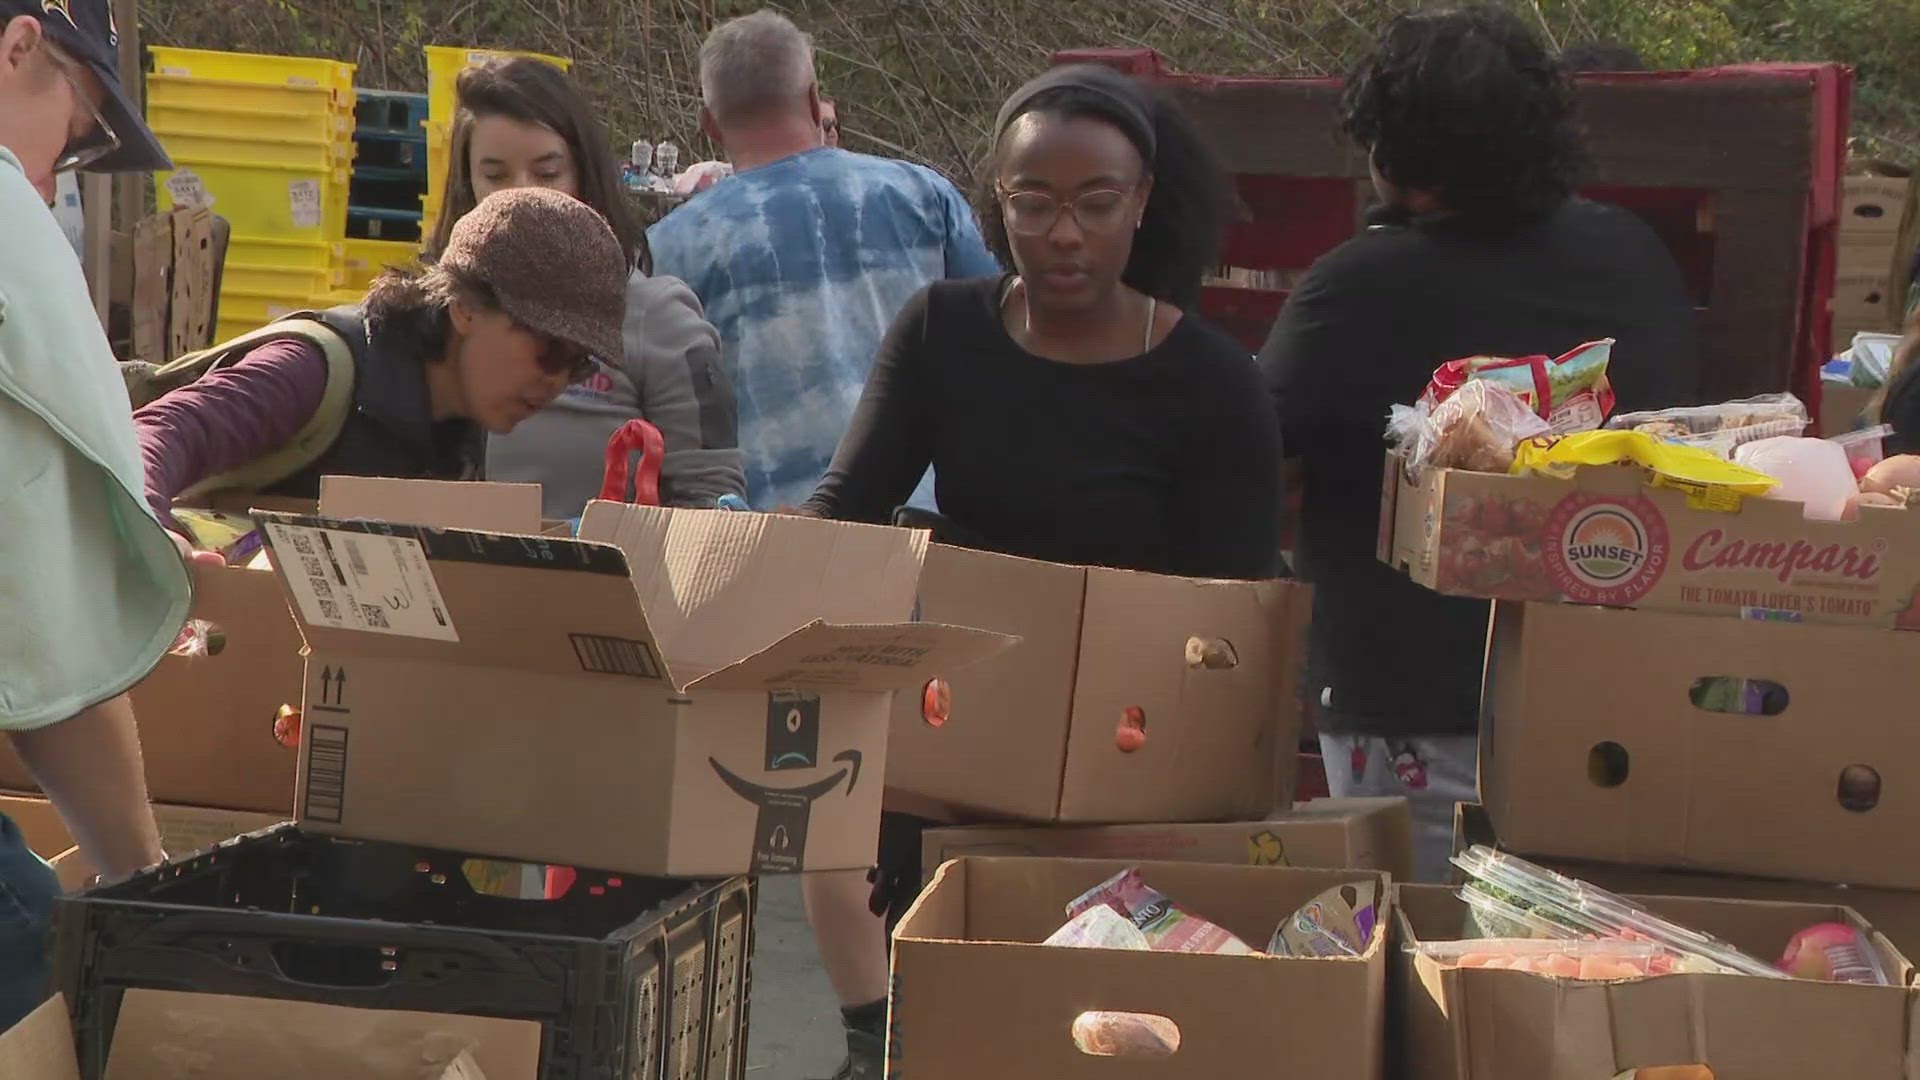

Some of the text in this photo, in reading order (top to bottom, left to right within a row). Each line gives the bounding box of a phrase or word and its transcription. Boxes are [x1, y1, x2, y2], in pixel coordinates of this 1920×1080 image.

[1546, 536, 1664, 602] INSPIRED BY FLAVOR
[1568, 544, 1644, 566] SUNSET
[1682, 528, 1880, 582] Campari
[383, 588, 410, 610] 3
[1680, 586, 1872, 616] THE TOMATO LOVER'S TOMATO
